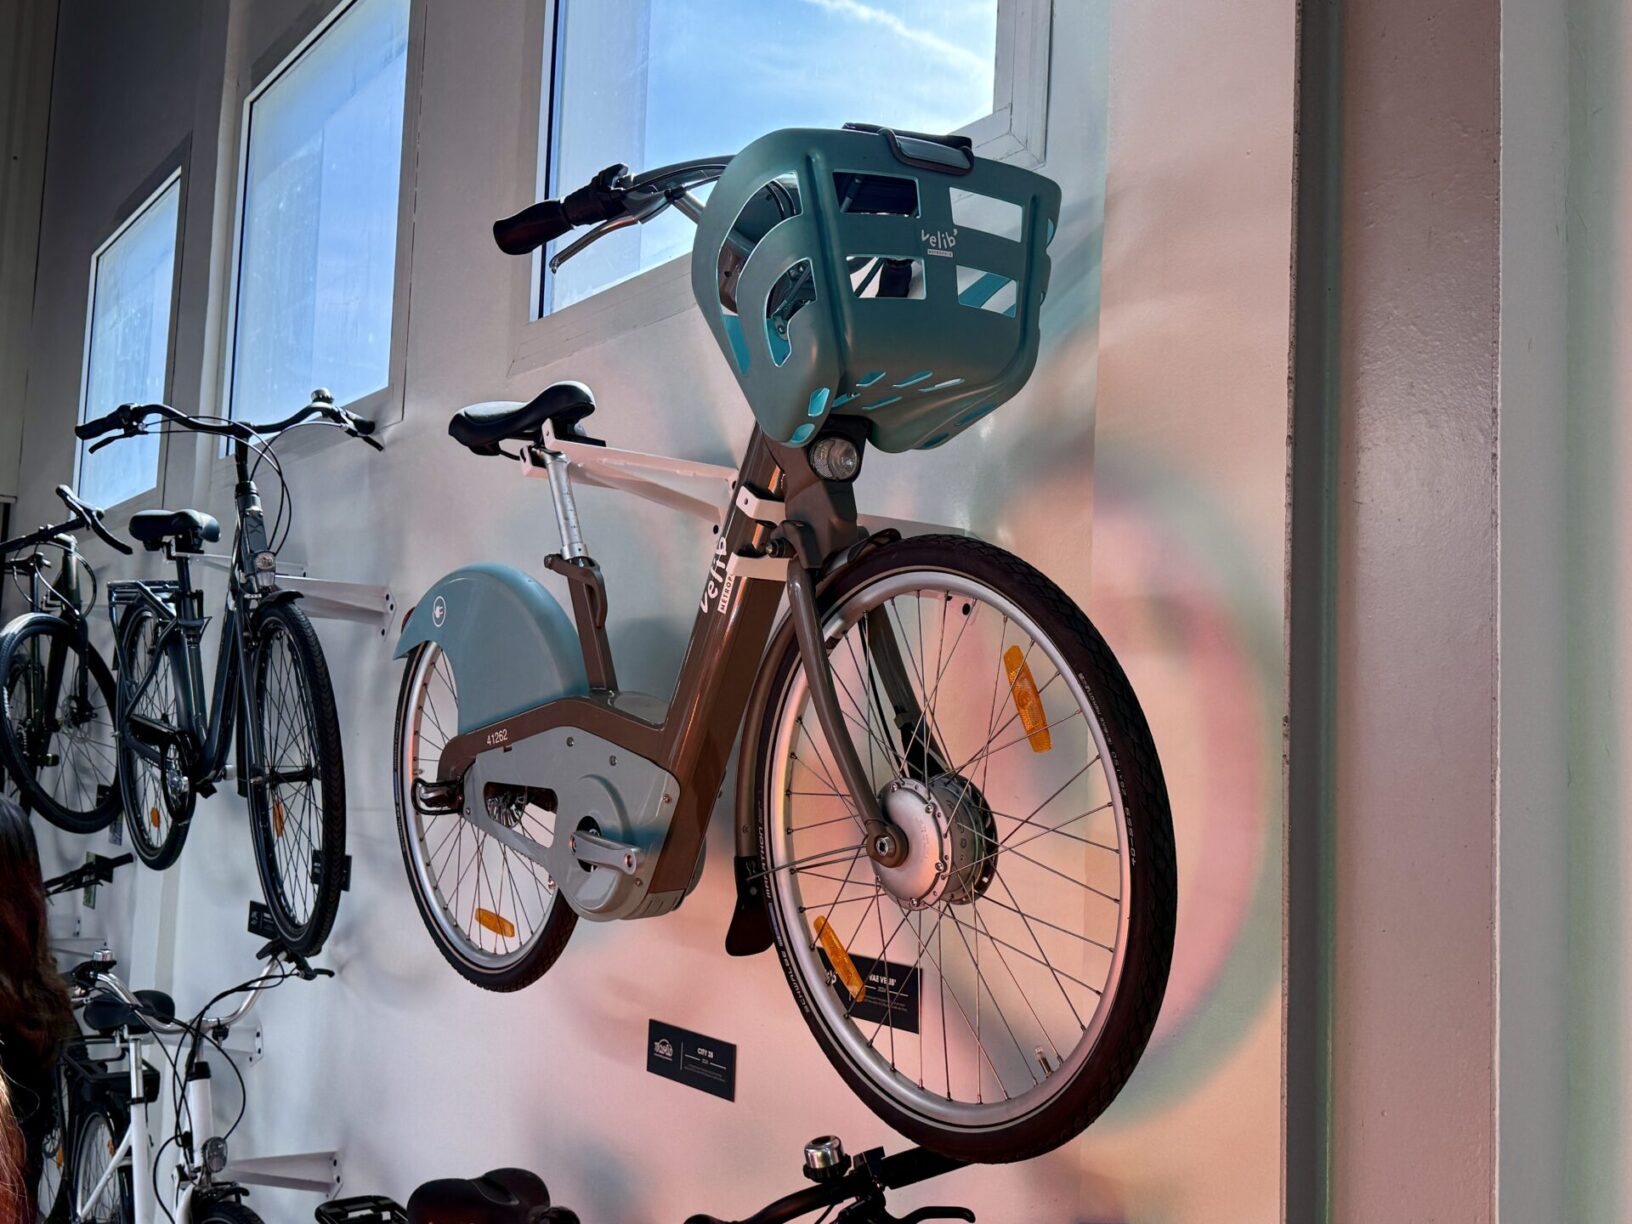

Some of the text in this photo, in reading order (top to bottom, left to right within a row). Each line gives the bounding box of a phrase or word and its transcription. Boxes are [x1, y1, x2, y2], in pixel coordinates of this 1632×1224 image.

[719, 573, 735, 612] METROP
[486, 728, 508, 746] 41262
[781, 949, 810, 1014] SCHWALBE
[697, 1047, 708, 1057] CITY
